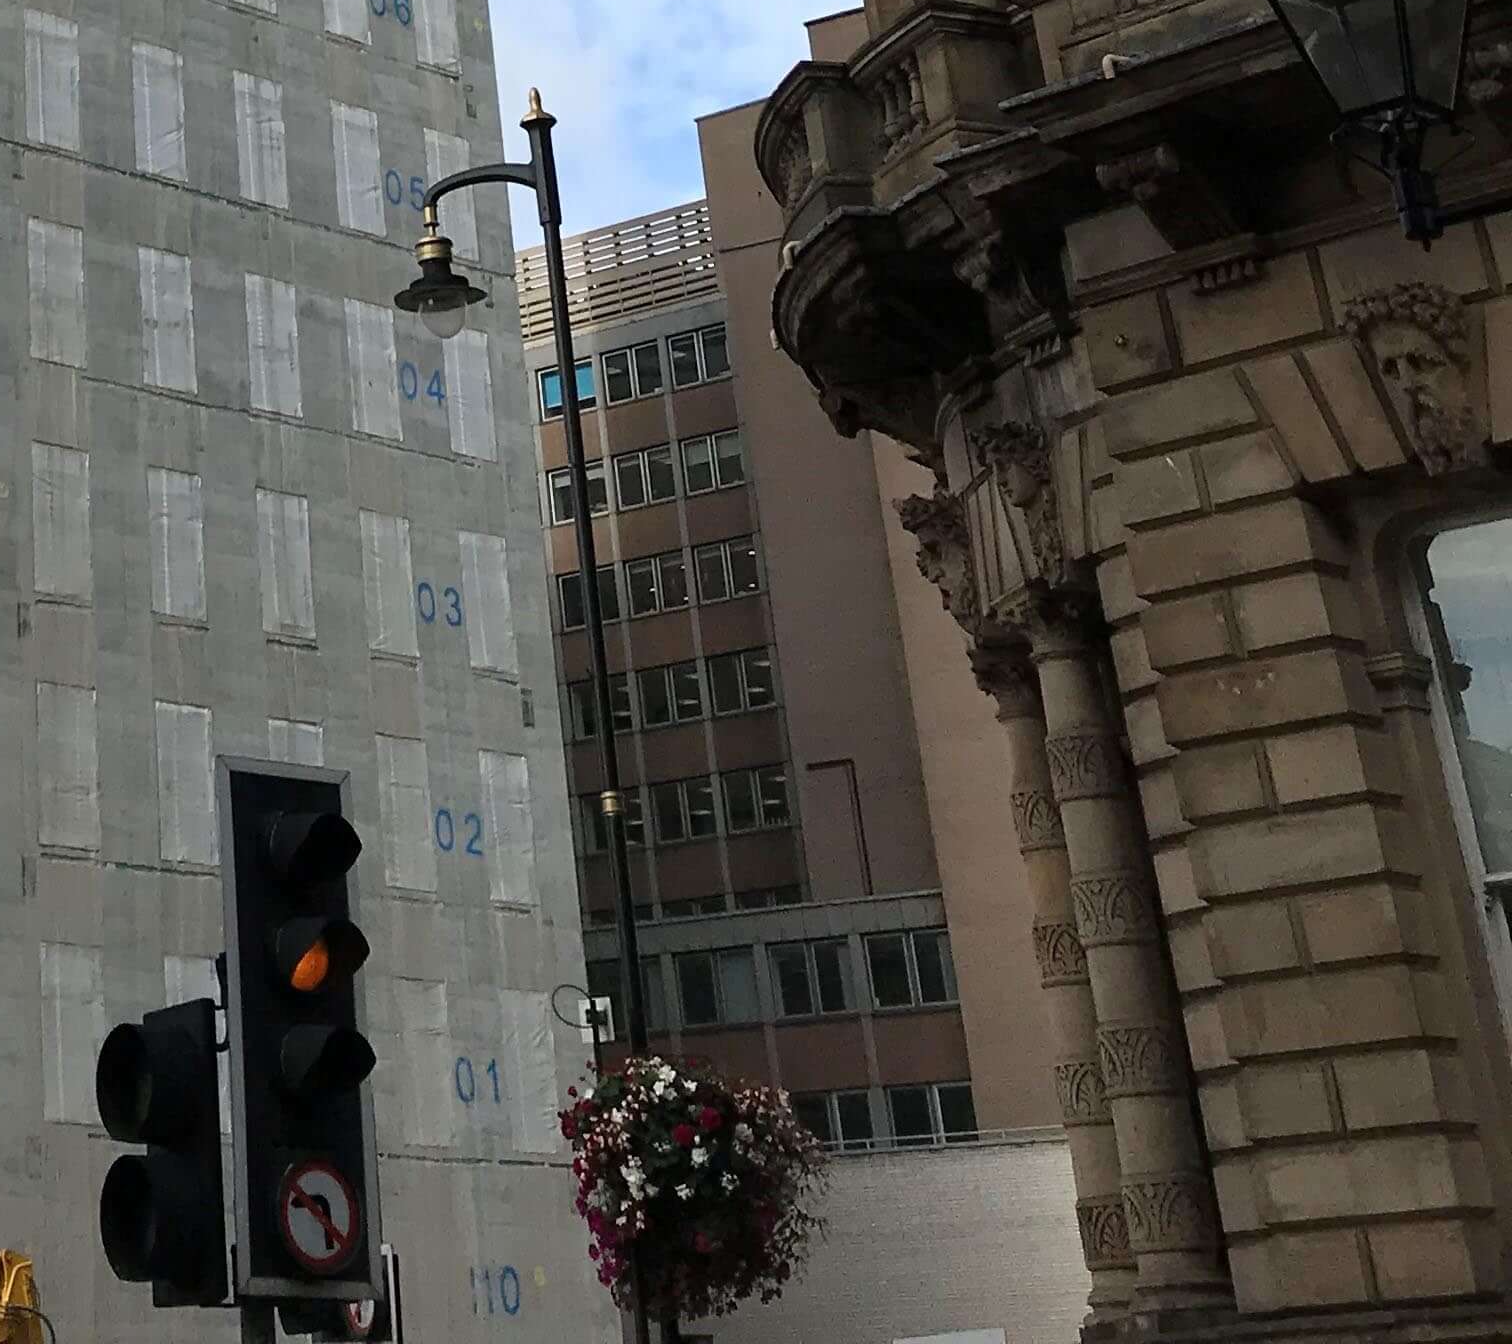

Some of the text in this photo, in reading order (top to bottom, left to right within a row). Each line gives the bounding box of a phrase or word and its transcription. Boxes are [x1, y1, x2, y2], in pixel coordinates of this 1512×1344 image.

[386, 169, 425, 212] 05
[400, 362, 446, 404] 04
[416, 581, 463, 626] 03
[435, 809, 483, 856] 02
[455, 1056, 500, 1104] 01
